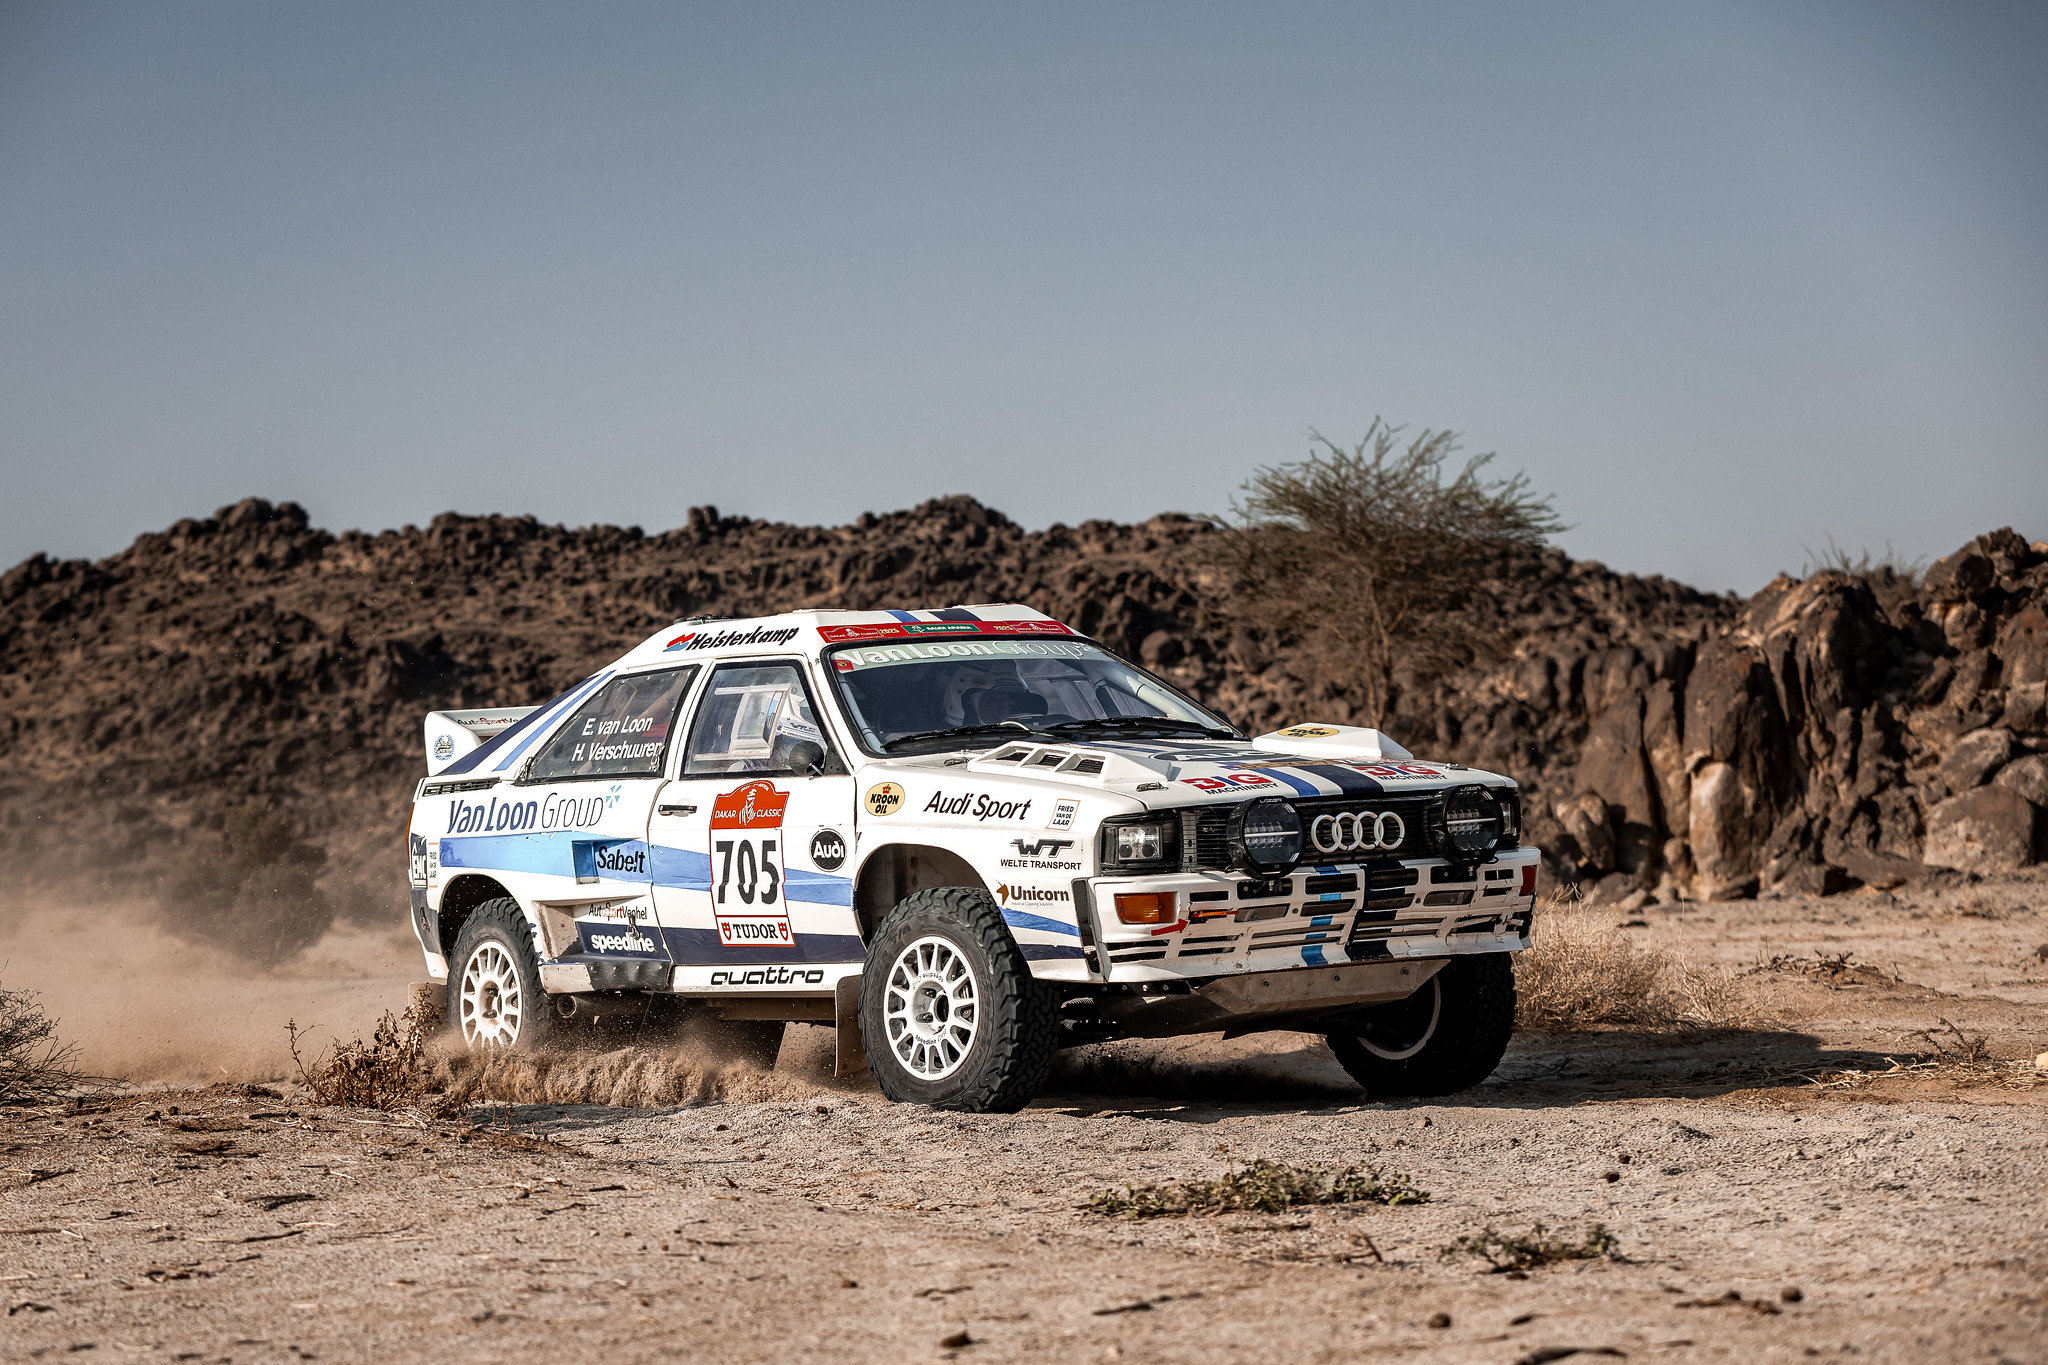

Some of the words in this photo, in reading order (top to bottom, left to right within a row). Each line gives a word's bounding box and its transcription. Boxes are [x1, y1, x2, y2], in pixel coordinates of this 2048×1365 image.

[685, 626, 800, 650] Heisterkamp
[993, 640, 1084, 660] Group
[581, 717, 597, 736] E.
[597, 719, 621, 735] van
[620, 715, 654, 734] Loon
[571, 742, 585, 762] H.
[870, 793, 900, 805] KROON
[923, 790, 974, 816] Audi
[972, 793, 1032, 822] Sport
[715, 809, 737, 819] DAKAR
[756, 808, 783, 818] CLASSIC
[874, 804, 887, 814] OIL
[1057, 805, 1075, 813] FRIED
[813, 840, 845, 859] Audi
[597, 845, 646, 874] Sabelt
[1000, 859, 1028, 868] WELTE
[1031, 860, 1082, 870] TRANSPORT
[715, 839, 780, 905] 705
[1010, 885, 1070, 901] Unicorn
[732, 924, 779, 939] TUDOR
[591, 931, 655, 953] speedline
[710, 966, 825, 985] quattro
